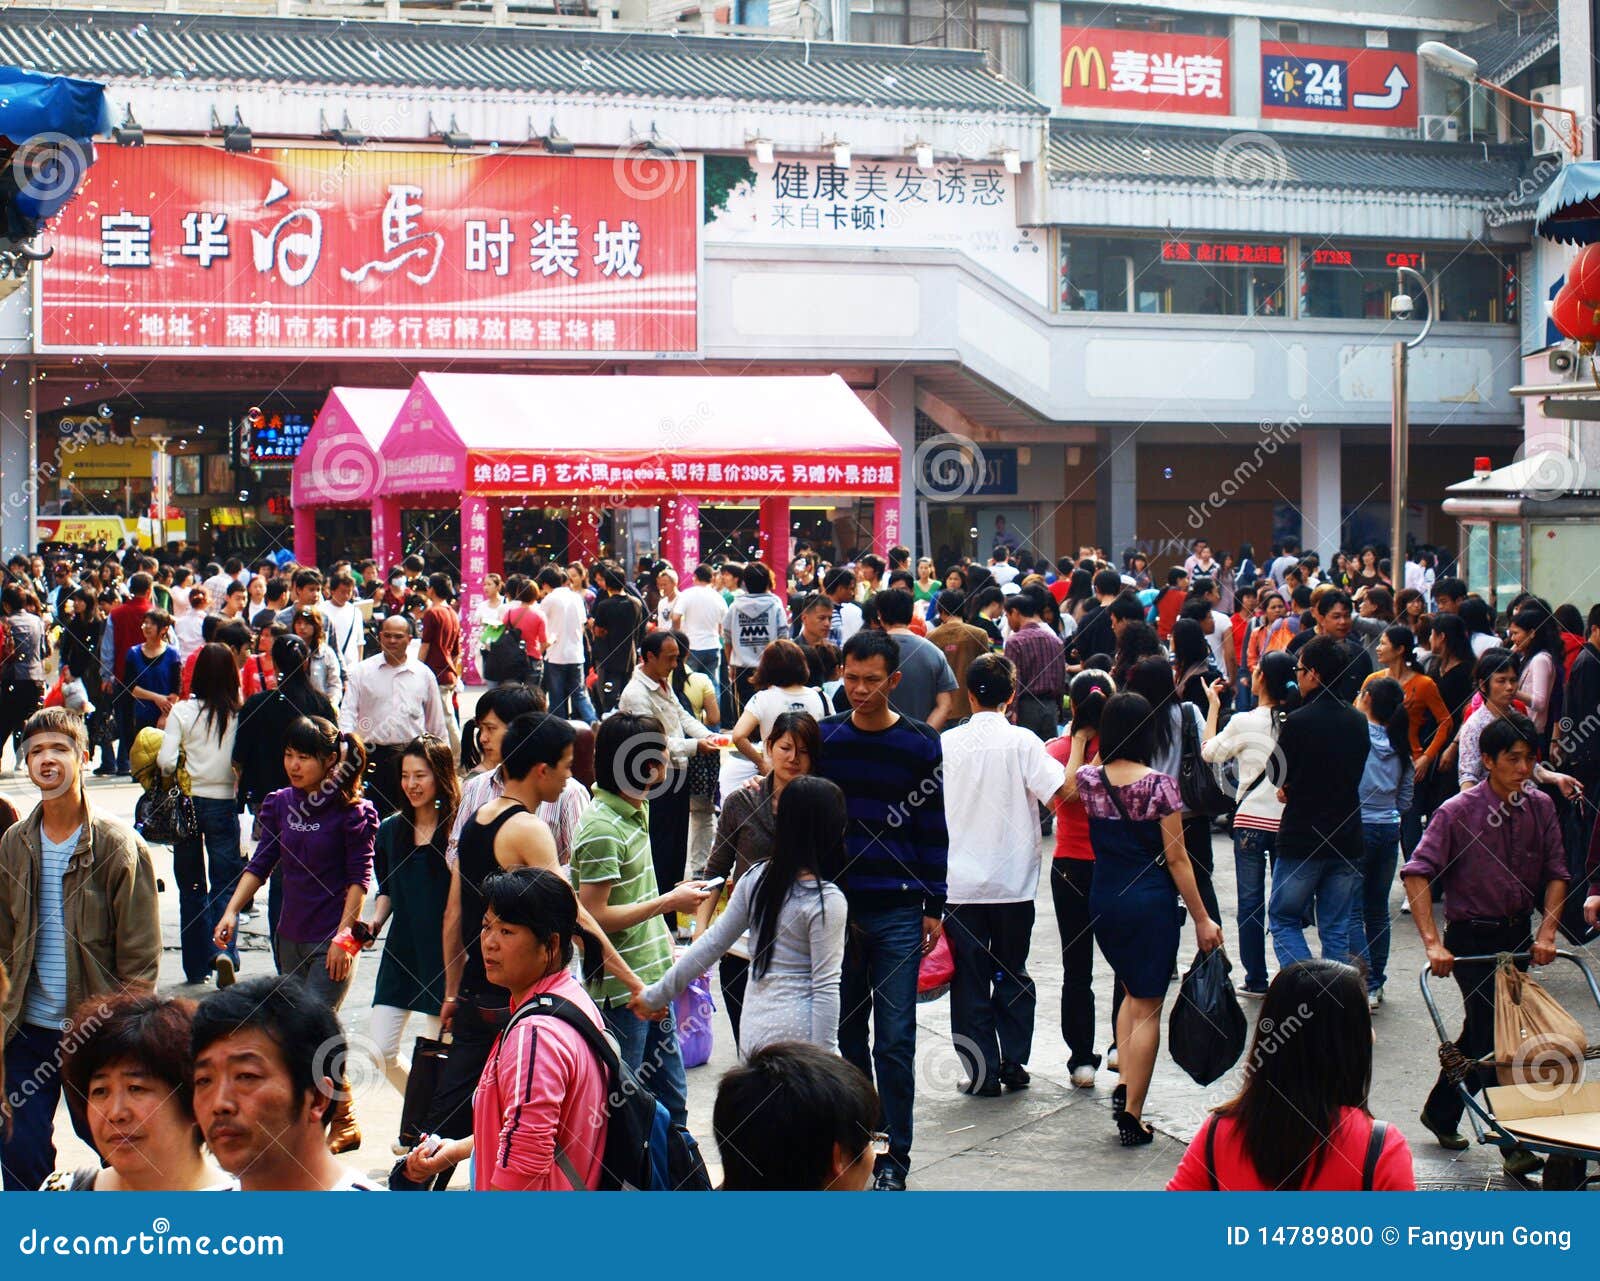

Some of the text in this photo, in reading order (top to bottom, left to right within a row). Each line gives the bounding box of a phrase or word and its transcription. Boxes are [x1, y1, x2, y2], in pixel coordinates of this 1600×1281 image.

[1110, 50, 1223, 98] 麦当劳
[1304, 63, 1343, 97] 24
[771, 162, 1005, 206] 健康美发诱惑
[474, 463, 547, 483] 缤纷三月
